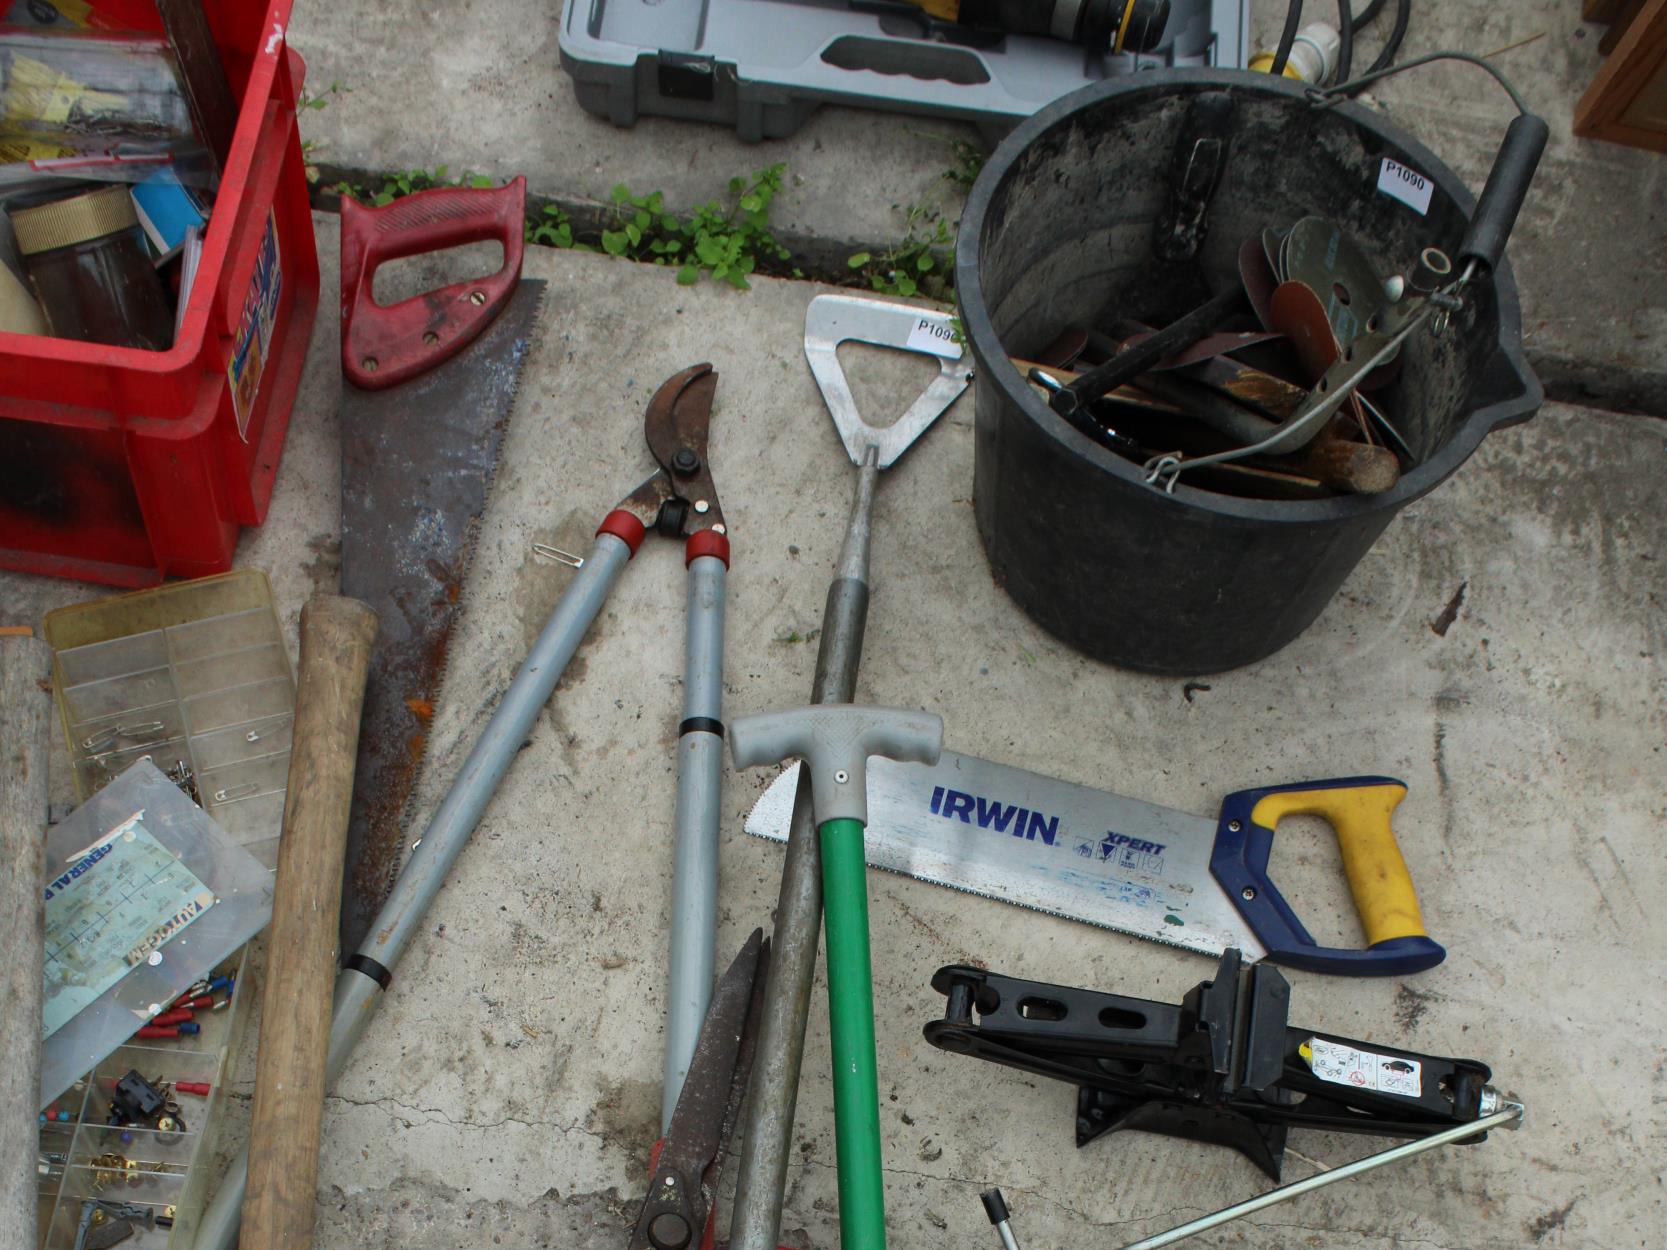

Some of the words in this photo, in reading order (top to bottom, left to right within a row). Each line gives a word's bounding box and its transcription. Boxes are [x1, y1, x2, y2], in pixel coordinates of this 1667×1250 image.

[1386, 161, 1425, 191] P1090
[918, 319, 956, 342] P109
[930, 785, 1060, 846] IRWIN
[1103, 830, 1167, 855] XPERT
[51, 842, 113, 892] GENERAL
